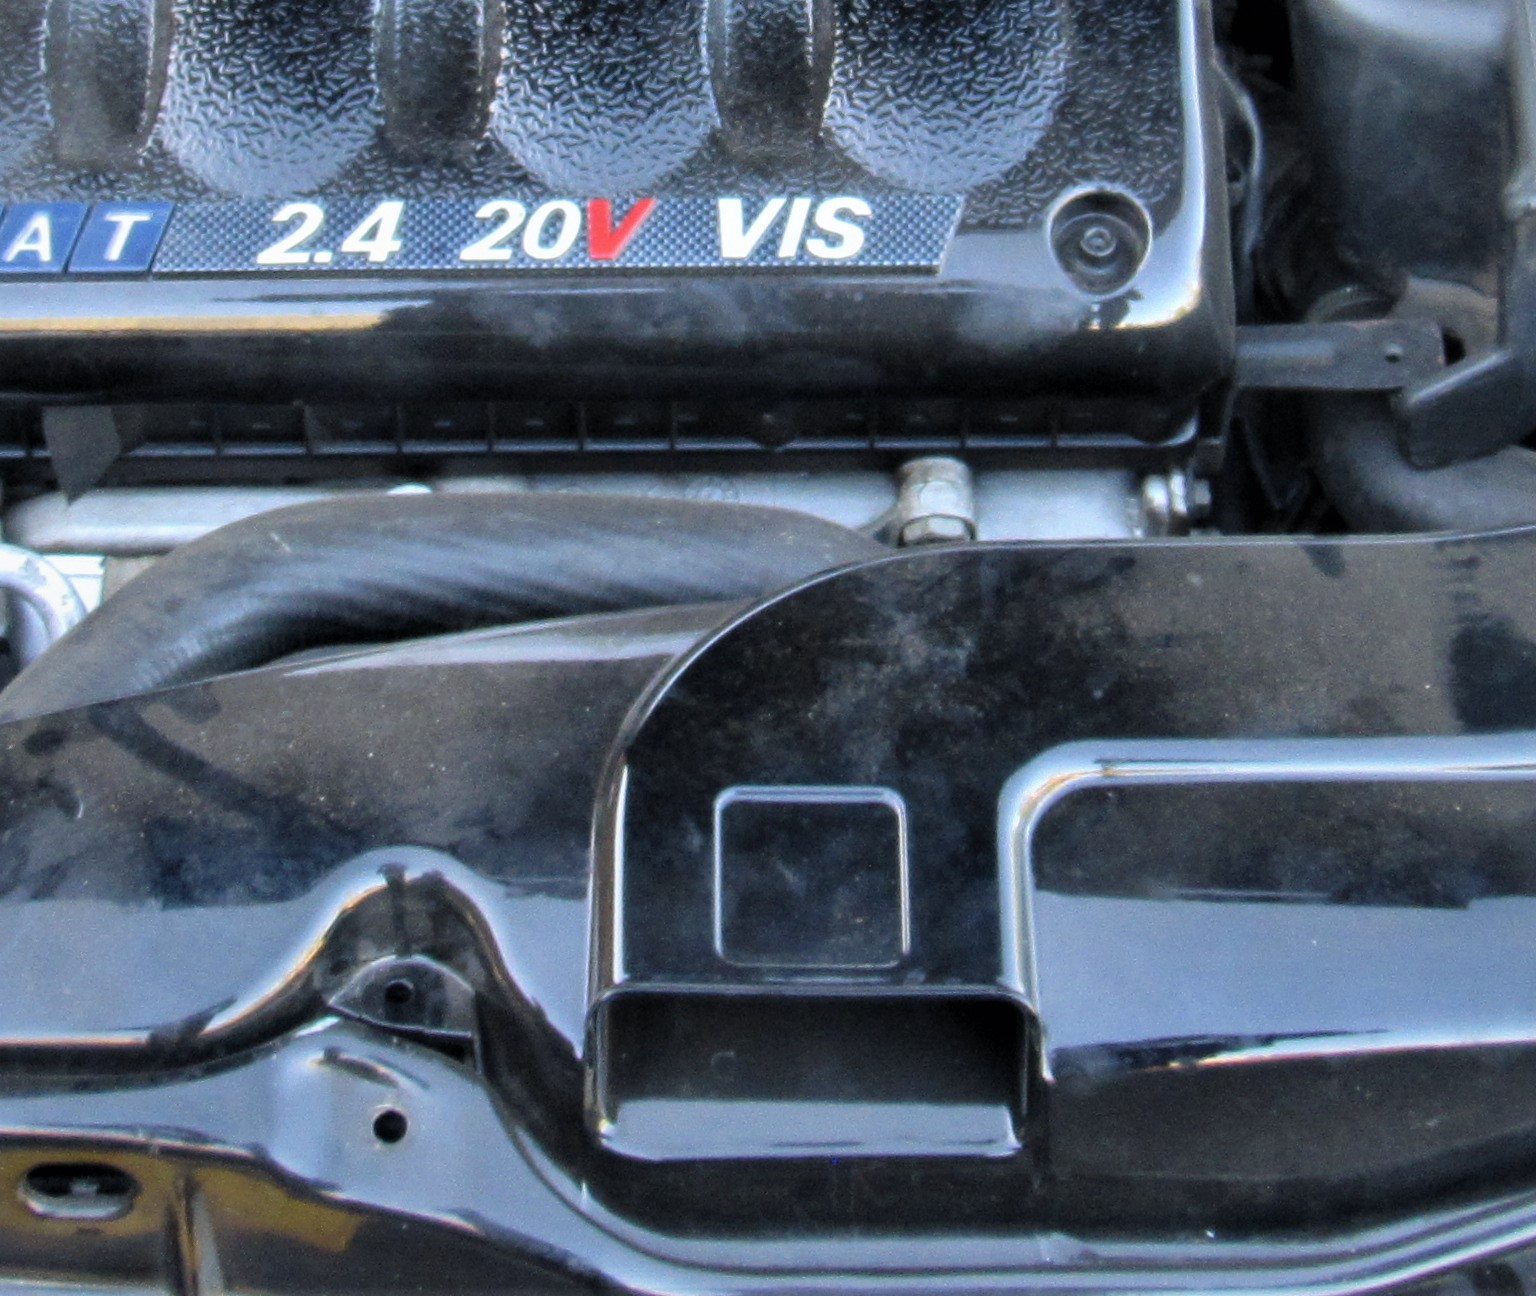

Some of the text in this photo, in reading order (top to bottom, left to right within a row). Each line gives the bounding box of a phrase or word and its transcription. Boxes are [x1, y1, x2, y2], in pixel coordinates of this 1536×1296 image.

[255, 200, 404, 262] 2.4
[460, 198, 654, 262] 20V
[716, 196, 872, 260] VIS
